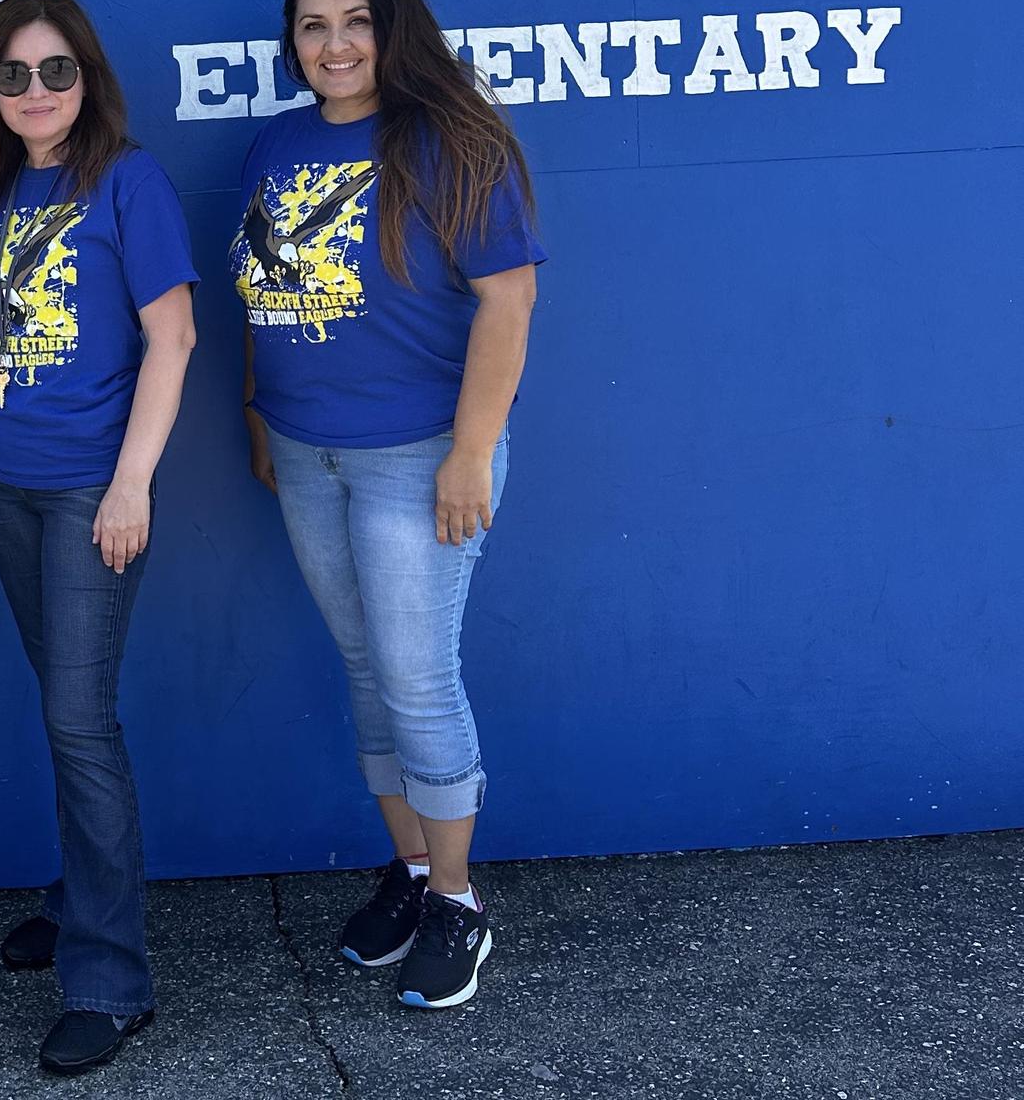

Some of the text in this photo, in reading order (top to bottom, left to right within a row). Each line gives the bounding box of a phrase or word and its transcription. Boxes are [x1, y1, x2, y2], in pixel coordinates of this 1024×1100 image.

[172, 7, 902, 121] ELENTARY
[303, 293, 360, 310] STREET
[267, 310, 297, 325] BOUND
[298, 307, 343, 324] EAGLES
[20, 336, 74, 353] STREET
[14, 352, 55, 368] EAGLES
